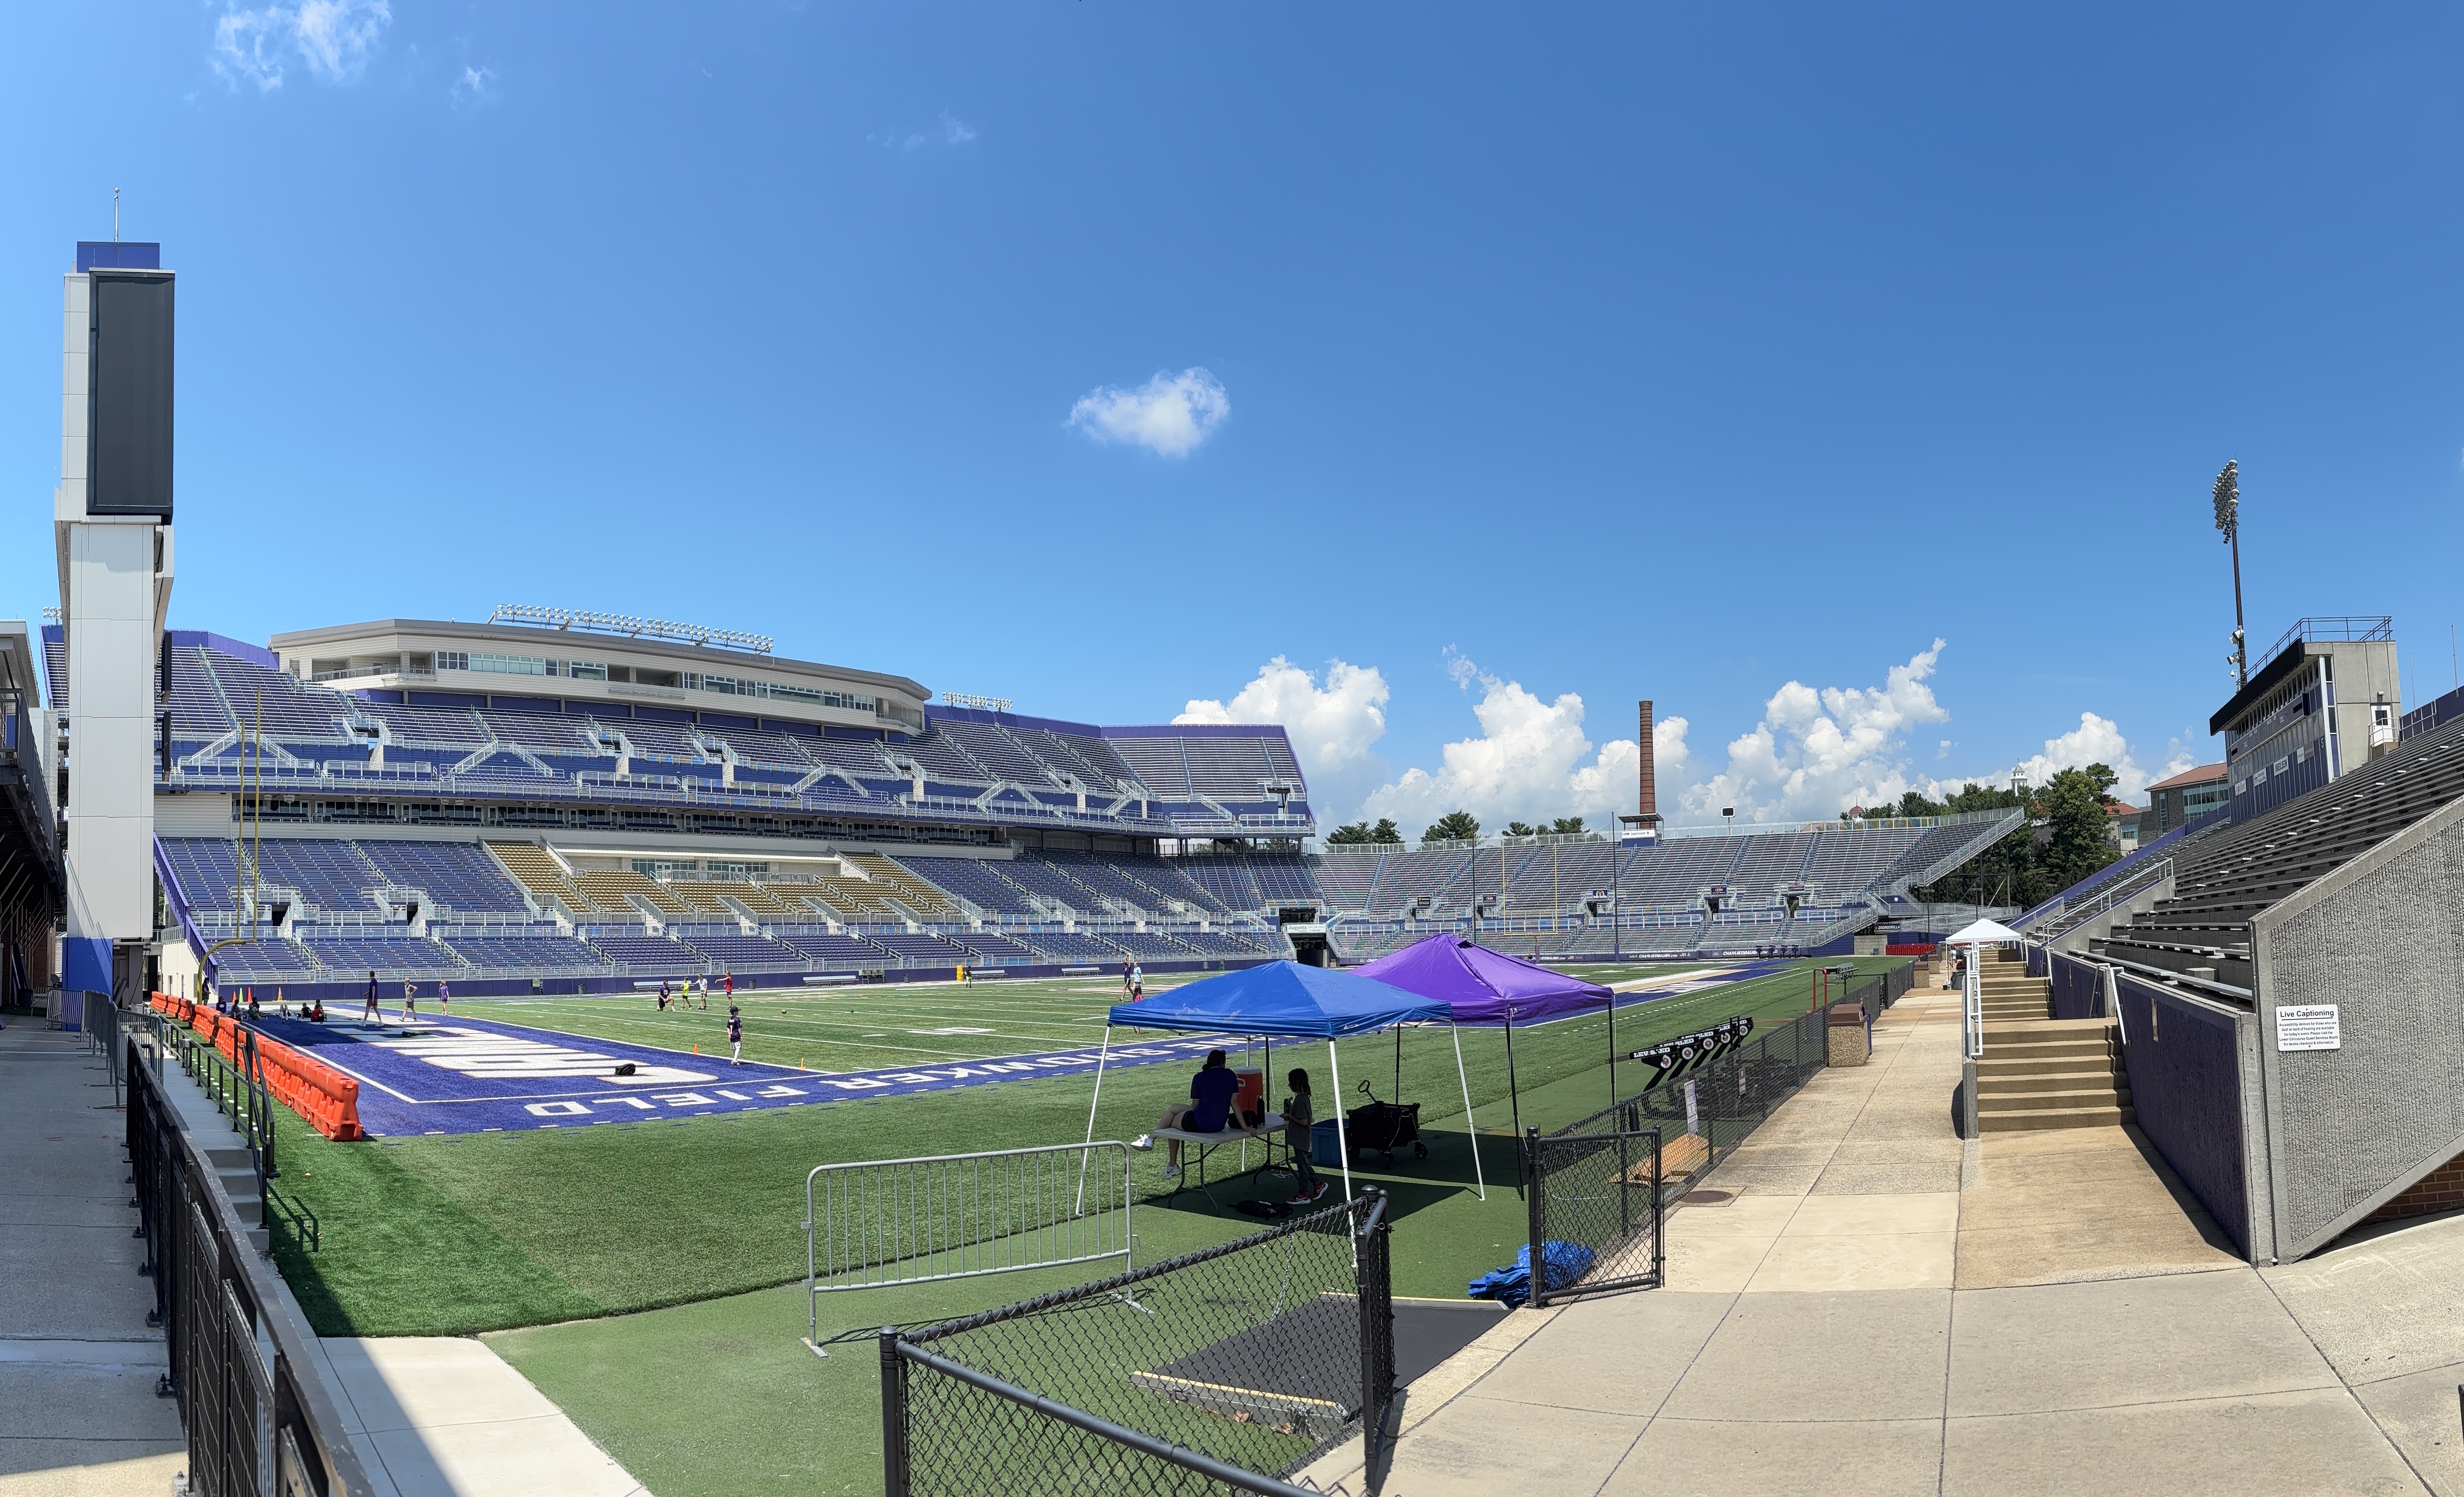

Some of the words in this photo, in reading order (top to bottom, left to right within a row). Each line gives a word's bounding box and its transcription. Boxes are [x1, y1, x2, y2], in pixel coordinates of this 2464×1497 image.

[730, 1025, 733, 1034] 1
[818, 1048, 1175, 1090] SHOWKER
[524, 1085, 809, 1116] FIELD
